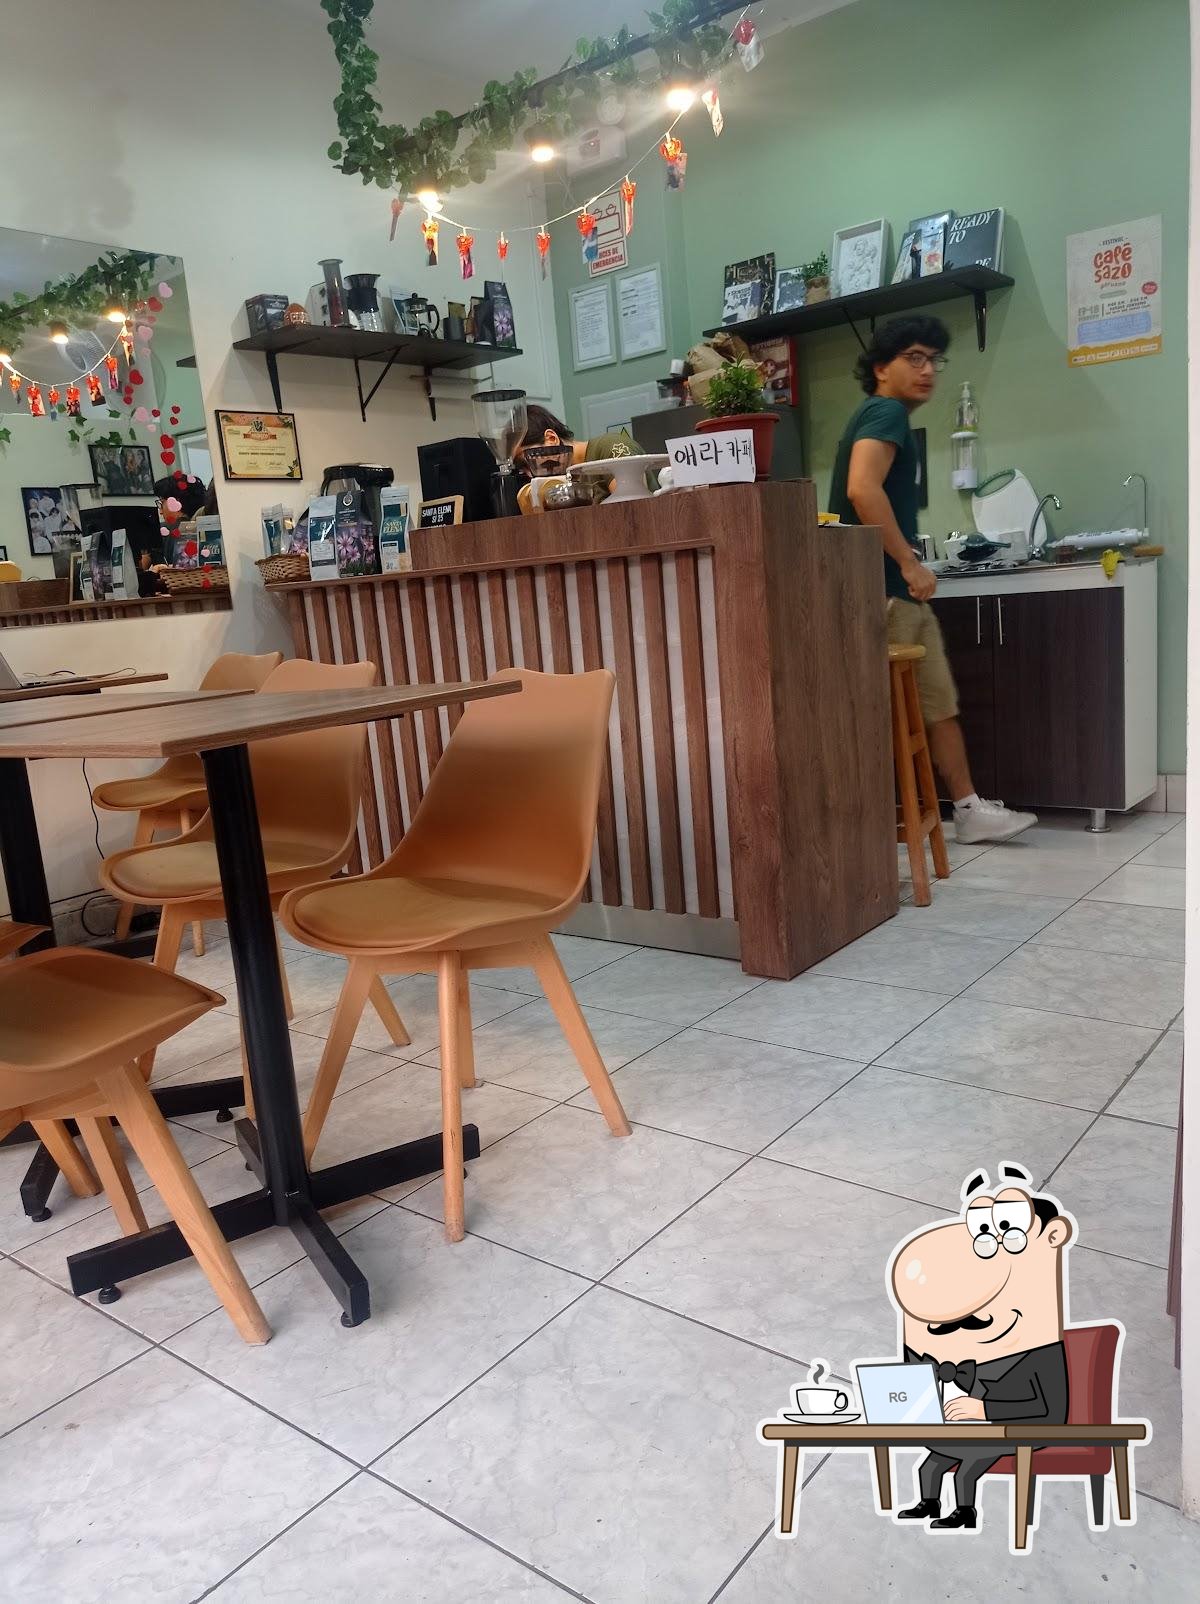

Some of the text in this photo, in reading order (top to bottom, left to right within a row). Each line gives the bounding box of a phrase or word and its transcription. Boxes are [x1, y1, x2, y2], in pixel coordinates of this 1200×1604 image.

[950, 211, 995, 232] READY
[949, 230, 966, 244] TO
[592, 254, 623, 270] EMERGENCIA
[421, 504, 452, 517] SANTA ELENA
